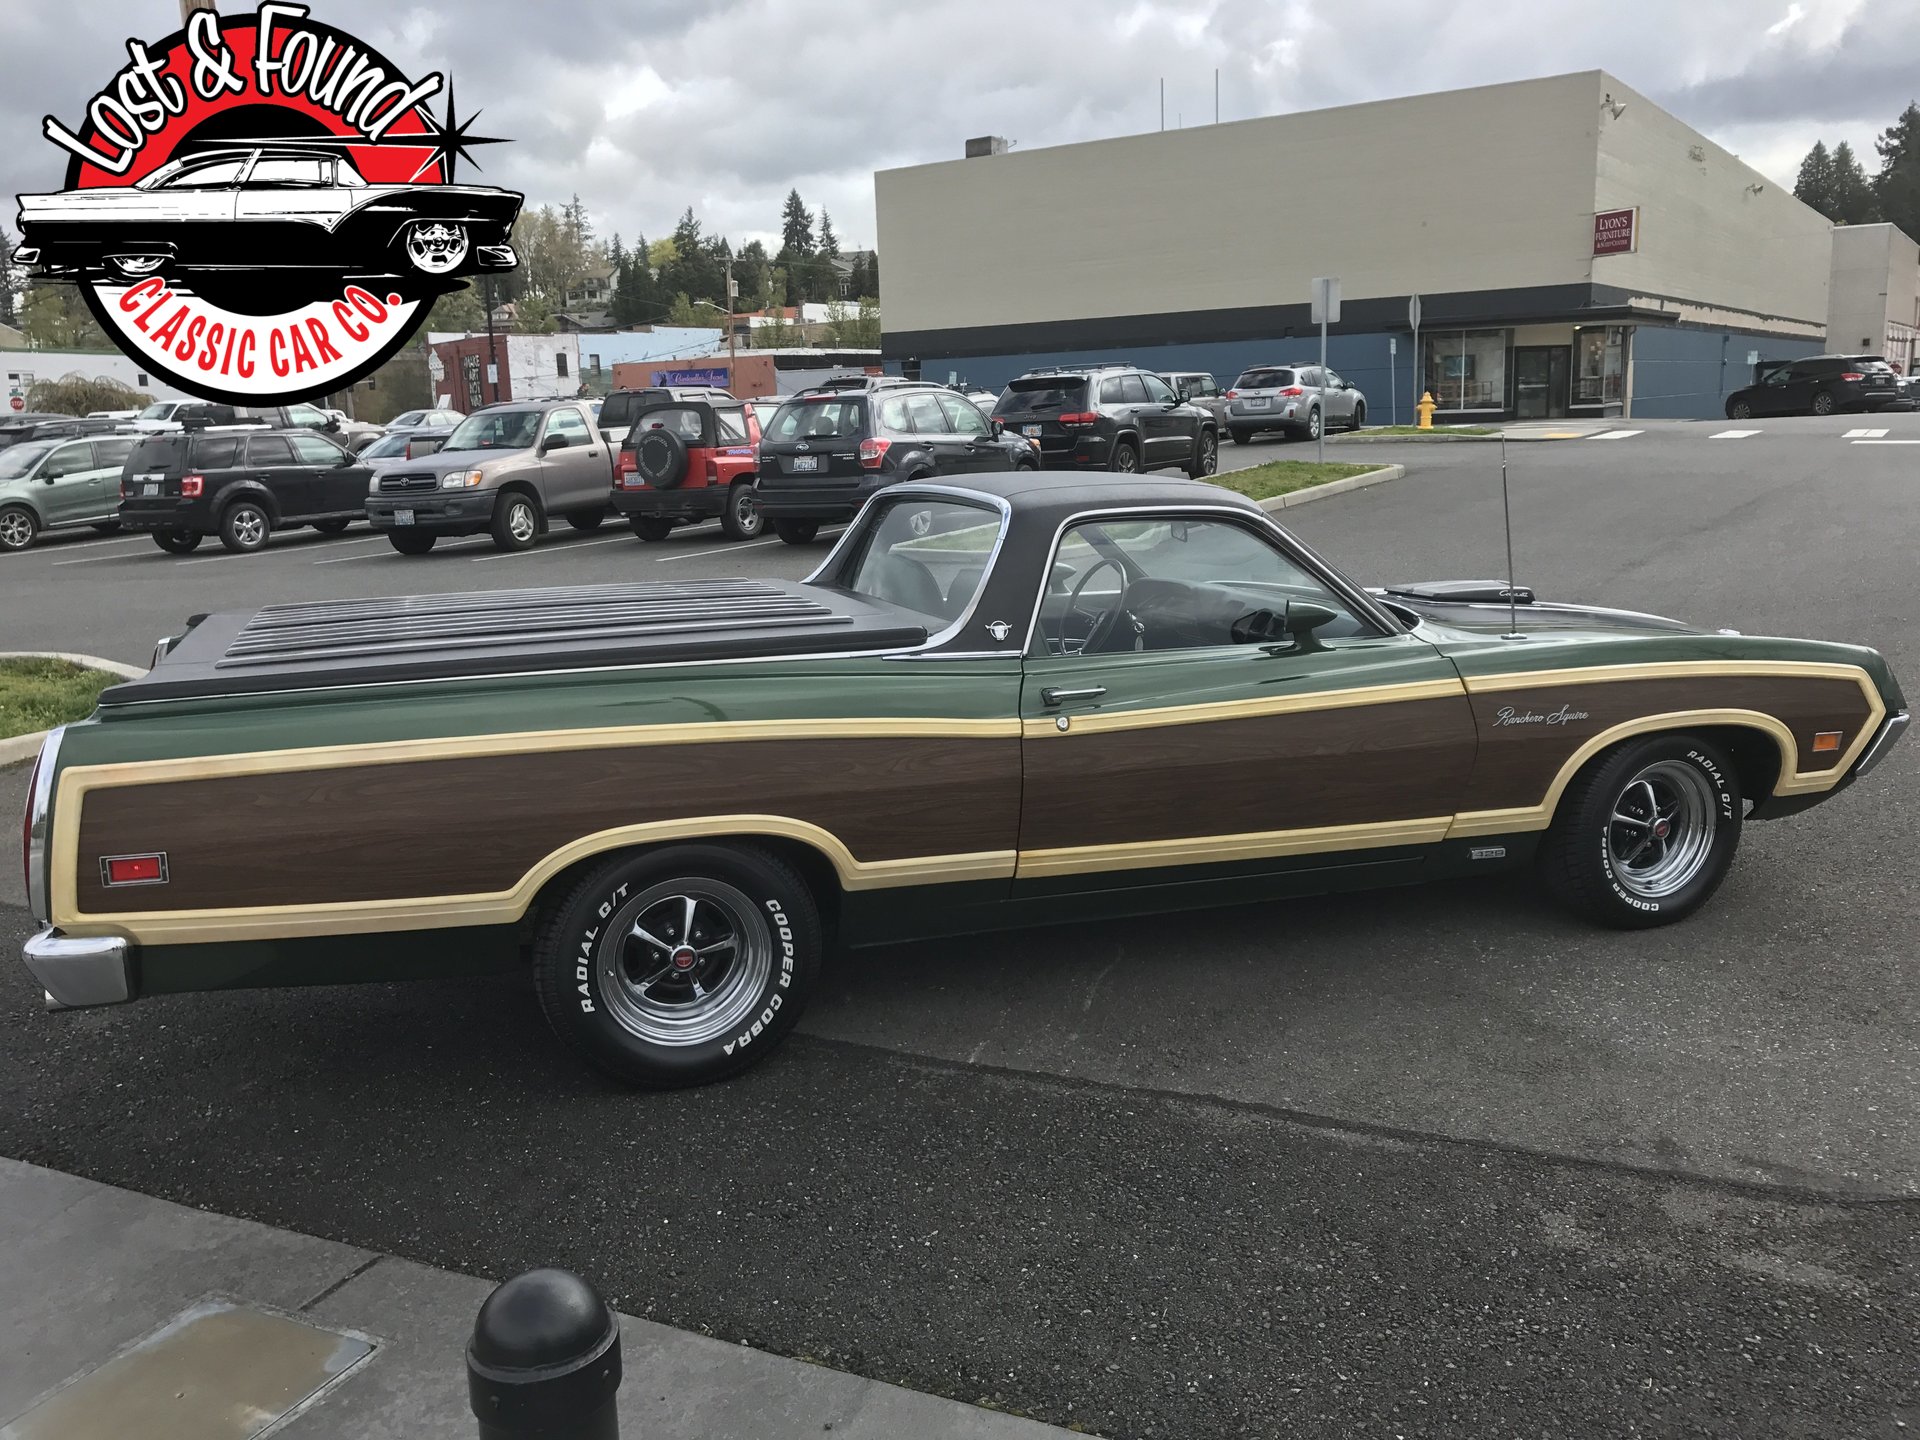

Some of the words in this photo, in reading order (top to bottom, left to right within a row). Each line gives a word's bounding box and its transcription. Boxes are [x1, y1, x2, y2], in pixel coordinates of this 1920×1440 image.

[1595, 228, 1631, 241] FURNITURE
[1600, 216, 1628, 230] LYON'S
[1492, 706, 1545, 727] Ranchero
[1546, 704, 1589, 726] Squire
[1687, 750, 1724, 789] RADIAL
[1721, 793, 1732, 819] G/T
[1612, 882, 1660, 912] COOPER
[576, 926, 599, 1013] RADIAL
[598, 882, 629, 919] G/T
[766, 899, 794, 988] COOPER
[723, 993, 783, 1055] COBRA
